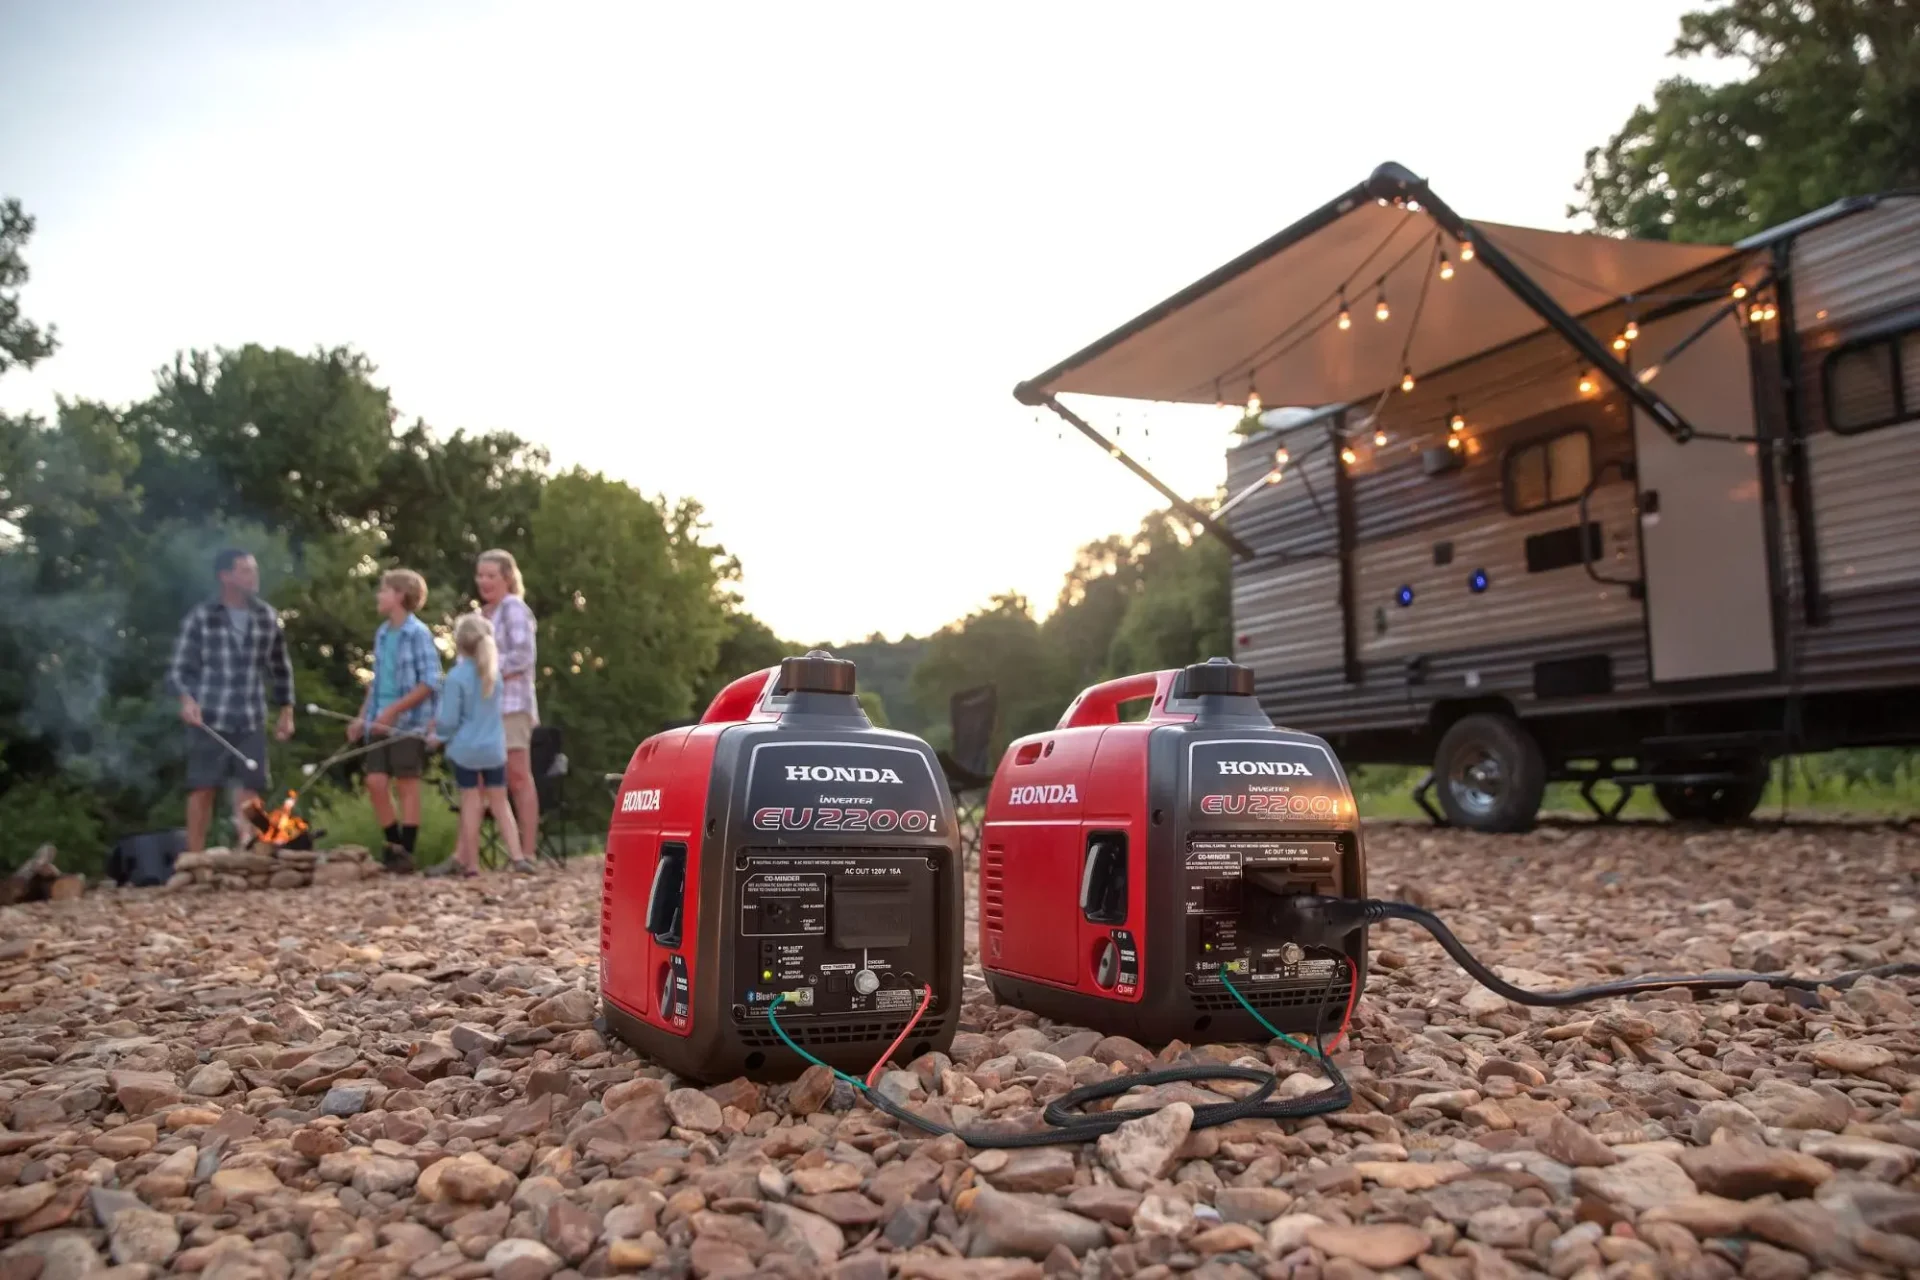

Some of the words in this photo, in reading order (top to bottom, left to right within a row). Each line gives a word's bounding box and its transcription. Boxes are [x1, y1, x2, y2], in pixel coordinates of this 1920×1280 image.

[785, 766, 903, 784] HONDA
[1217, 761, 1313, 776] HONDA
[621, 788, 660, 812] HONDA
[1008, 784, 1079, 805] HONDA
[1201, 795, 1339, 815] EU2200i
[753, 807, 938, 832] EU2200i
